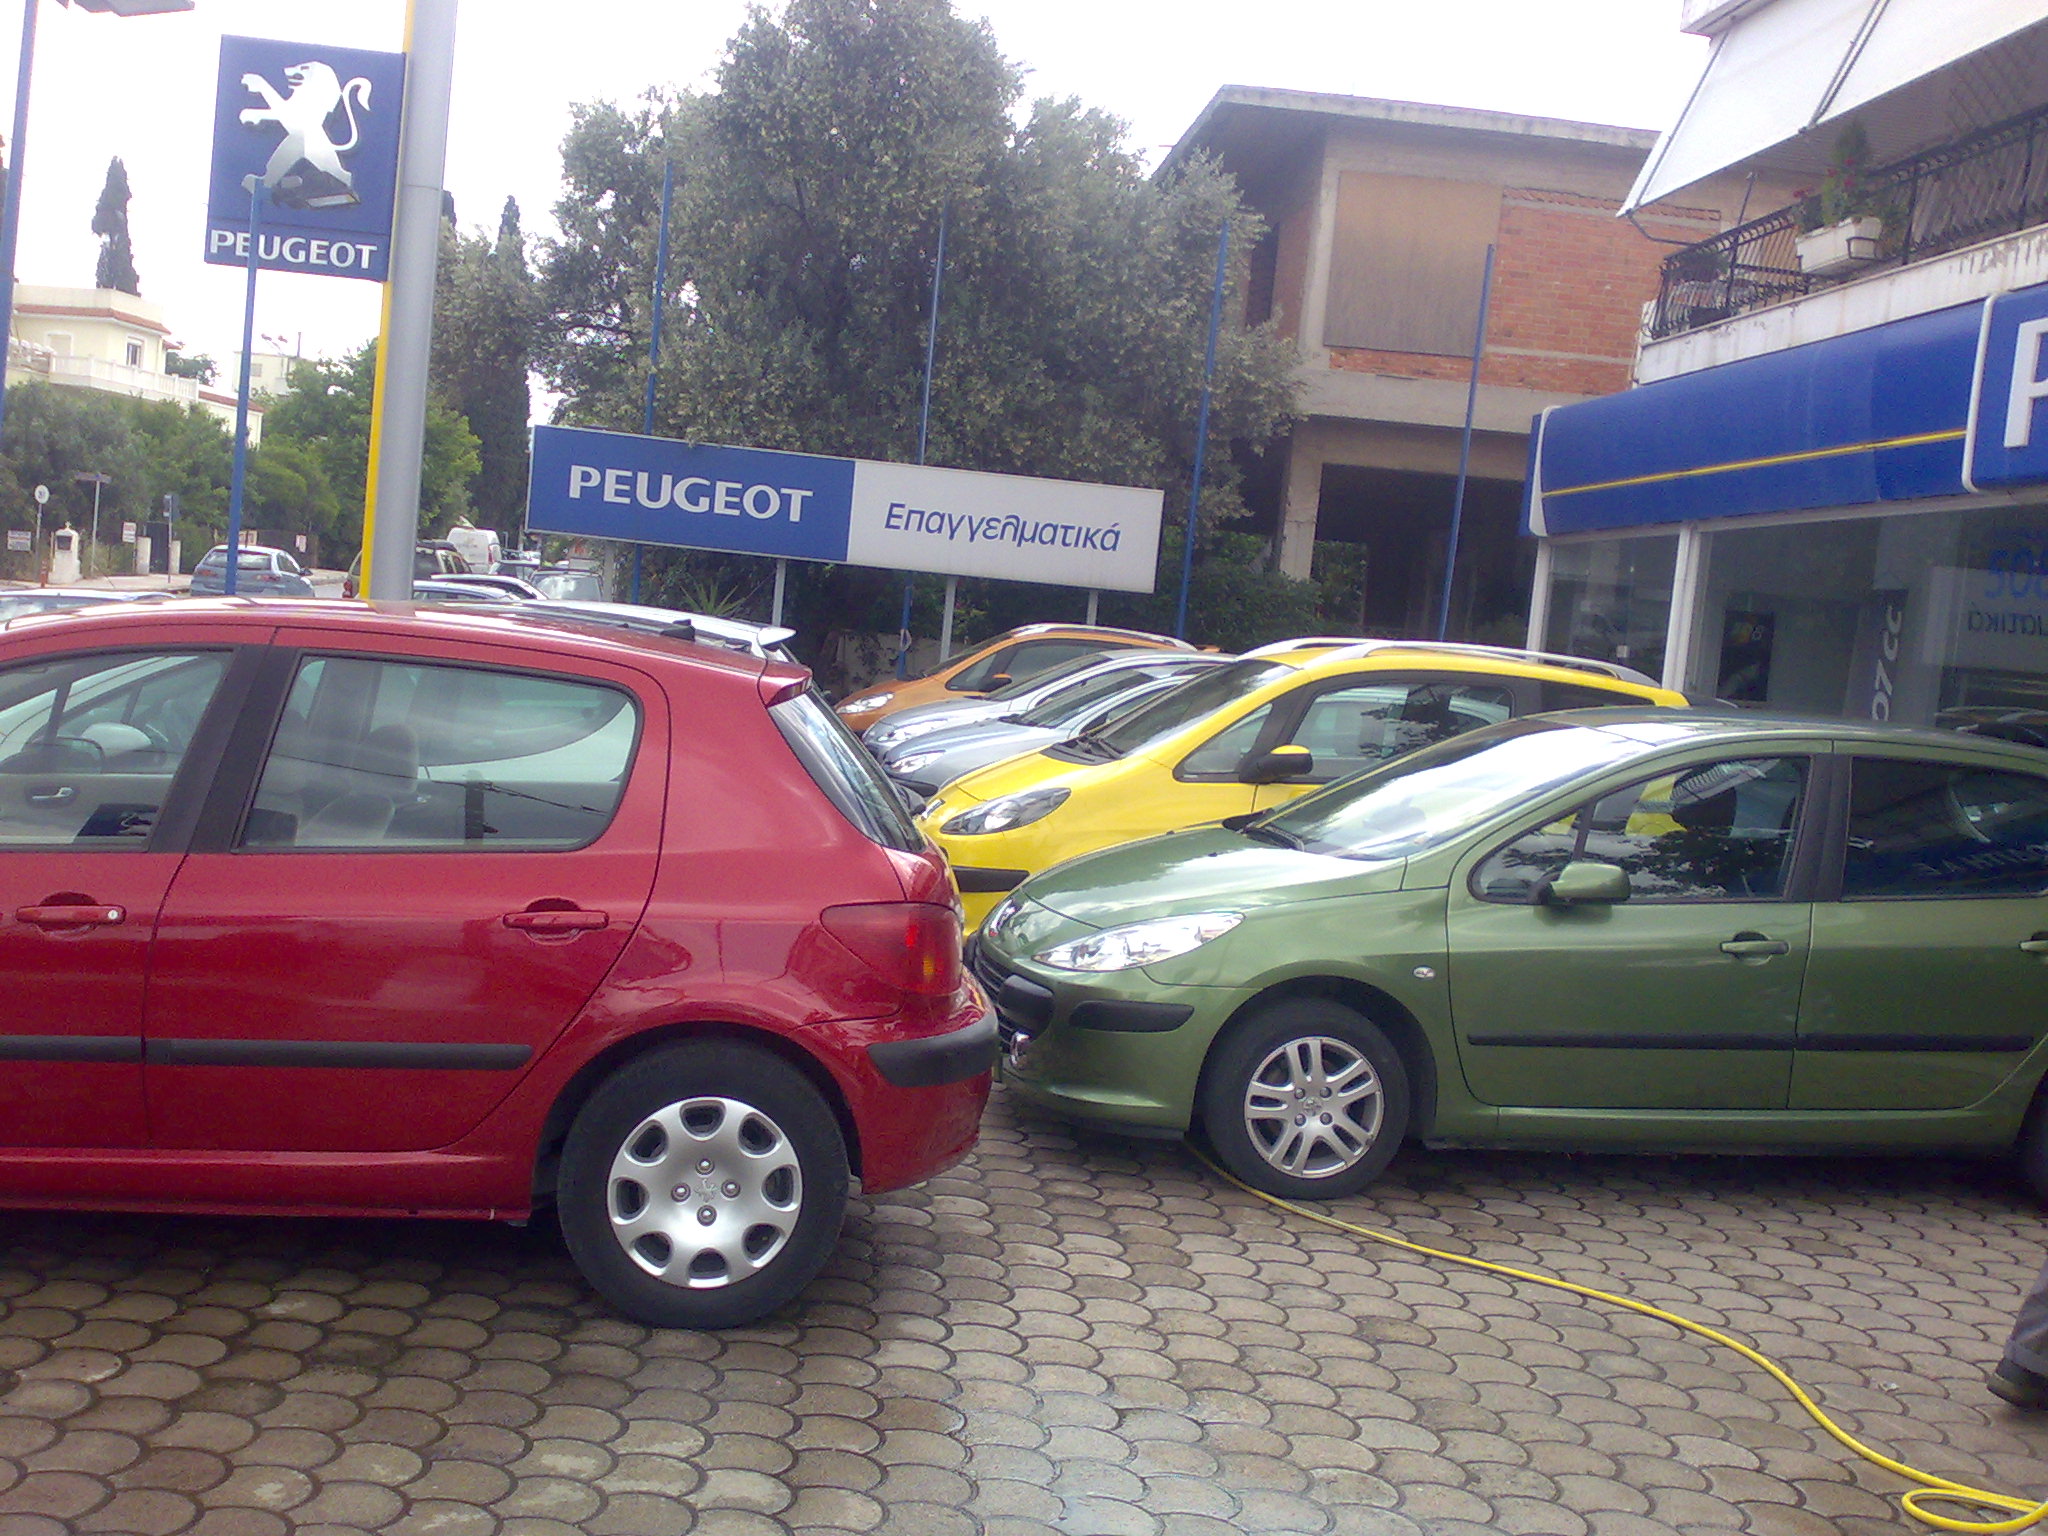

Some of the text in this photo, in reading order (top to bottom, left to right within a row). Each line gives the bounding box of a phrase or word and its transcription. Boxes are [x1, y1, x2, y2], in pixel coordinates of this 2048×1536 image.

[210, 229, 378, 269] PEUGEOT
[568, 464, 814, 523] PEUGEOT
[884, 502, 1121, 552] Επαγγελματικά
